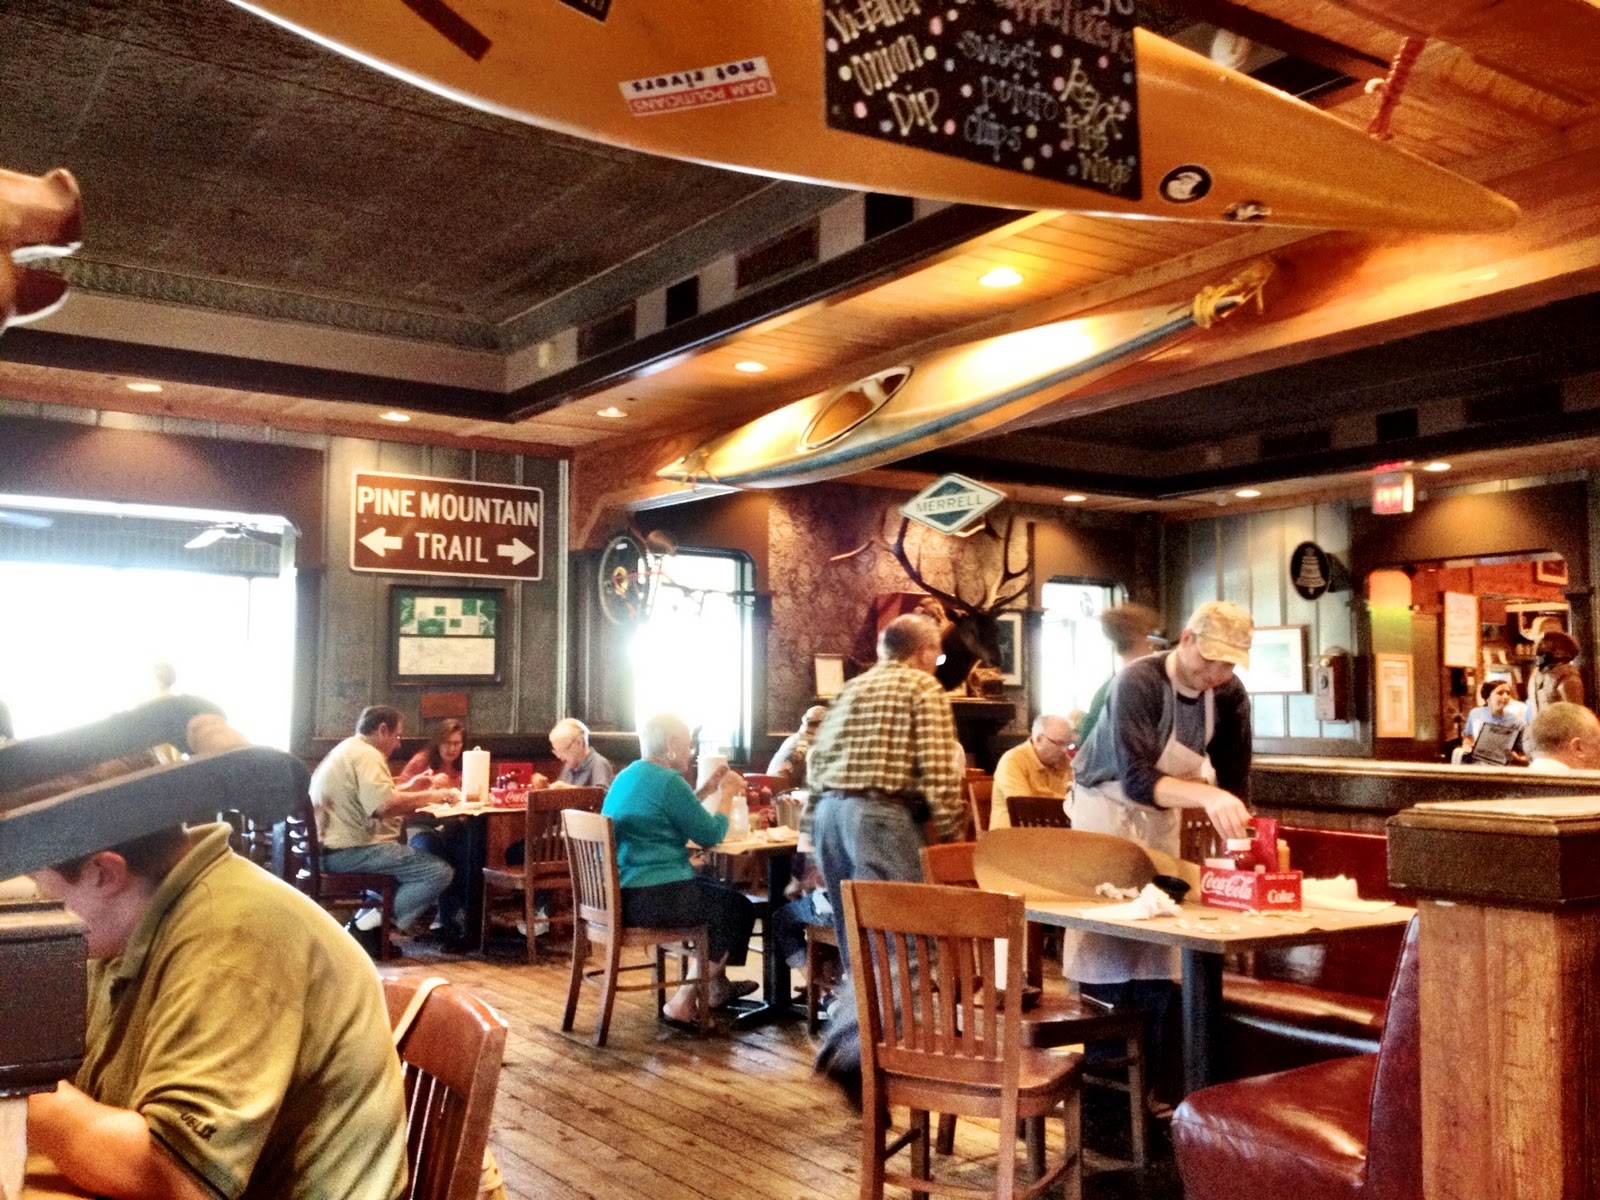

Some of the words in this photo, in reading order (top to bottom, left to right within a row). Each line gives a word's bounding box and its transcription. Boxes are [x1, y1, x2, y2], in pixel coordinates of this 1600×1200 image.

[631, 69, 705, 93] rivers
[714, 60, 757, 81] not
[356, 485, 416, 518] PINE
[420, 491, 539, 528] MOUNTAIN
[916, 493, 984, 513] MERRELL
[414, 531, 489, 564] TRAIL
